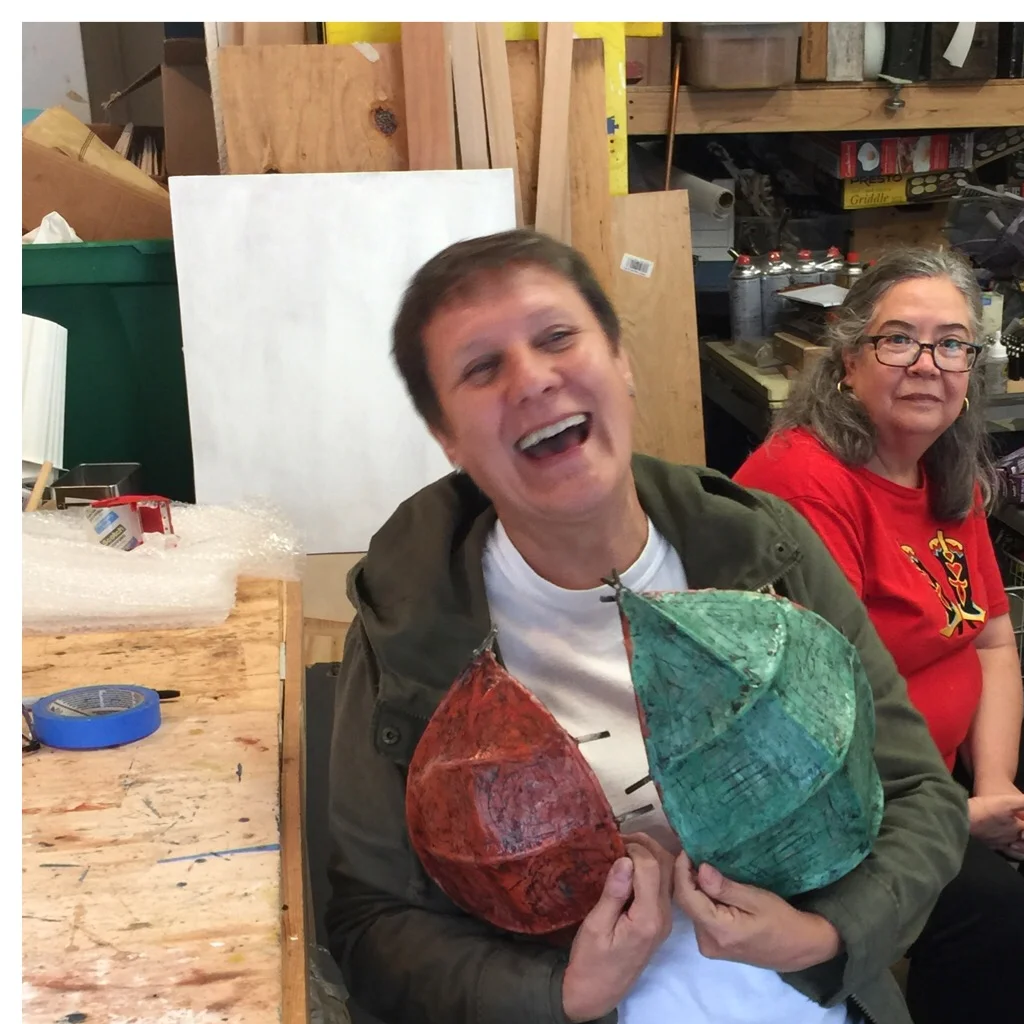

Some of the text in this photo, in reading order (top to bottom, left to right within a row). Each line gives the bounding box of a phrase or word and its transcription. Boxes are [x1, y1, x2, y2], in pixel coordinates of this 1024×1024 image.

[850, 174, 903, 187] PRESTO
[850, 192, 889, 205] Griddle
[101, 526, 126, 545] Scotch
